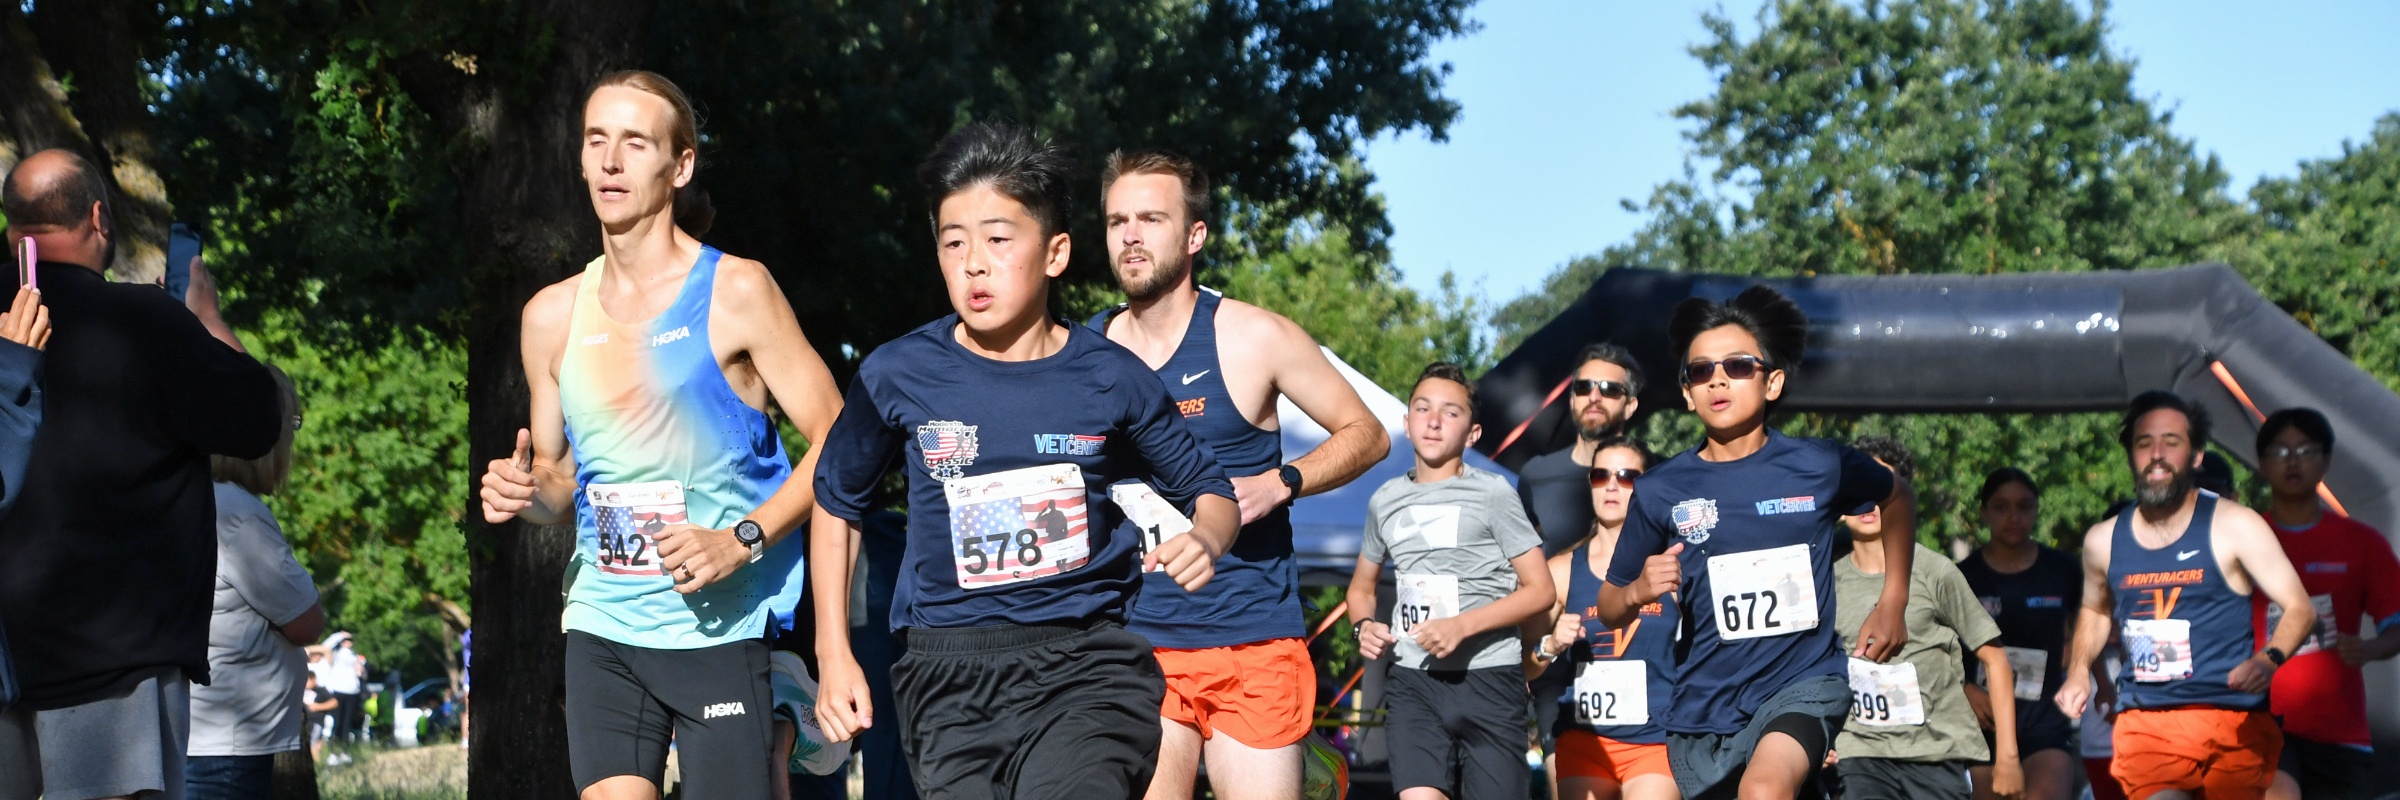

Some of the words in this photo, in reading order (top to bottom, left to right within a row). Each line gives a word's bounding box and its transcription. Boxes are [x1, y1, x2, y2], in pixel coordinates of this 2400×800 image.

[652, 326, 690, 347] HOKA
[1066, 439, 1104, 456] CENTE
[925, 457, 974, 466] CLASSIC
[600, 532, 649, 567] 542
[963, 528, 1042, 575] 578
[2126, 568, 2204, 586] VENTURACERS
[1722, 590, 1782, 632] 672
[2130, 652, 2160, 672] 49
[704, 701, 745, 720] HOKA
[1579, 691, 1617, 720] 692
[1852, 690, 1890, 721] 699
